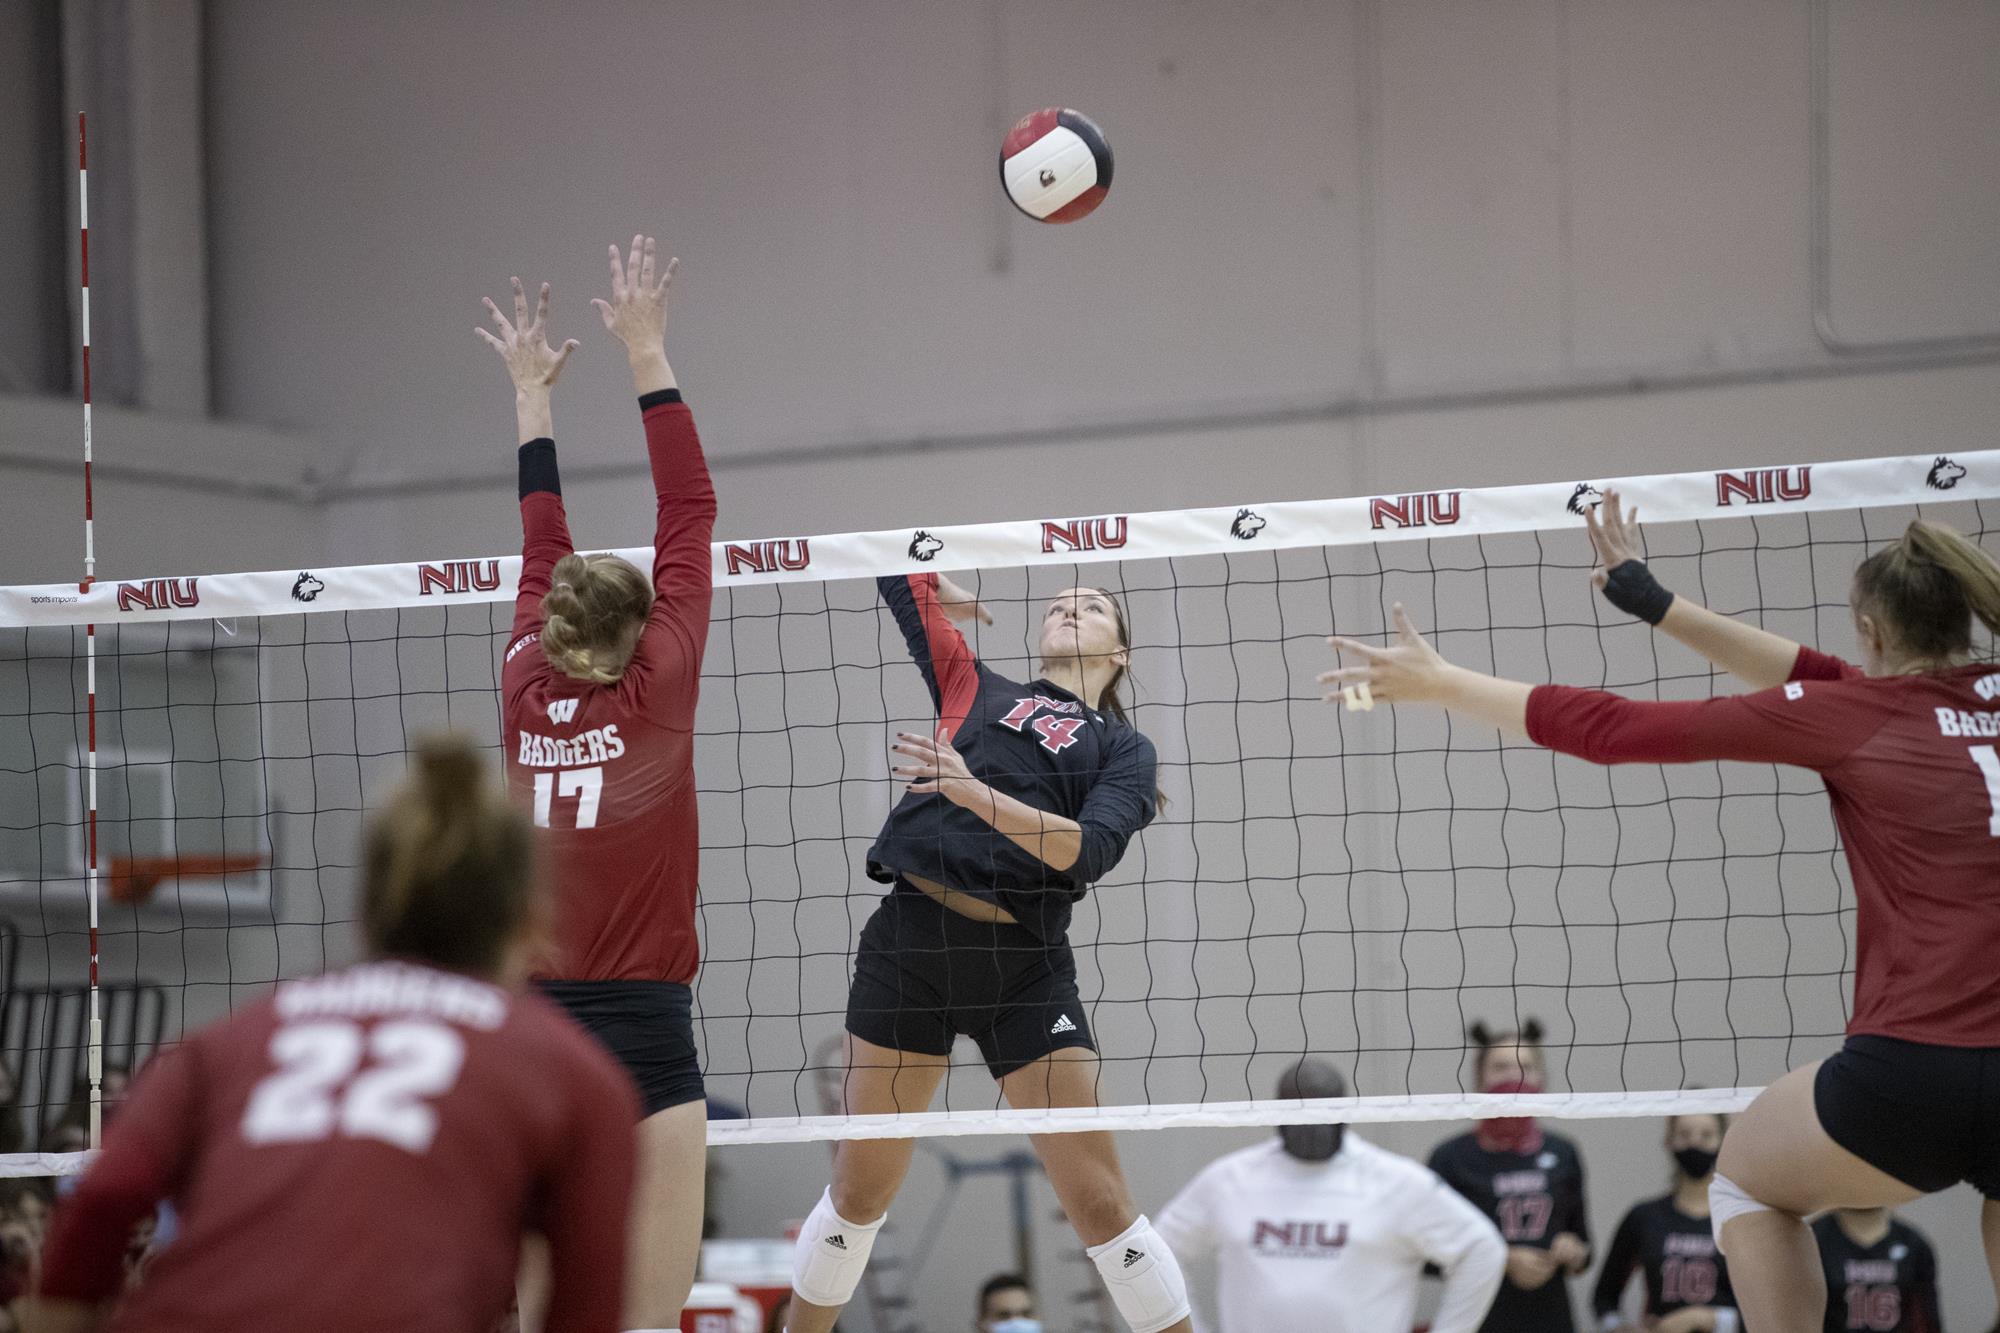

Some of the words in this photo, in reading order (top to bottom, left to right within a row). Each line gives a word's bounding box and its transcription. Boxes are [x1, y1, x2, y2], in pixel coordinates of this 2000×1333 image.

[1715, 466, 1812, 507] NIU
[1369, 491, 1463, 530] NIU
[1041, 515, 1128, 553] NIU
[725, 539, 812, 576] NIU
[117, 577, 200, 612] NIU
[418, 559, 501, 596] NIU
[30, 595, 51, 605] sports
[546, 698, 580, 726] W
[999, 696, 1088, 755] 14
[518, 723, 626, 768] BADGERS
[533, 766, 604, 829] 17
[1051, 1023, 1077, 1034] adidas
[241, 1022, 466, 1155] 22
[1252, 1220, 1349, 1250] NIU
[1123, 1251, 1145, 1268] adidas
